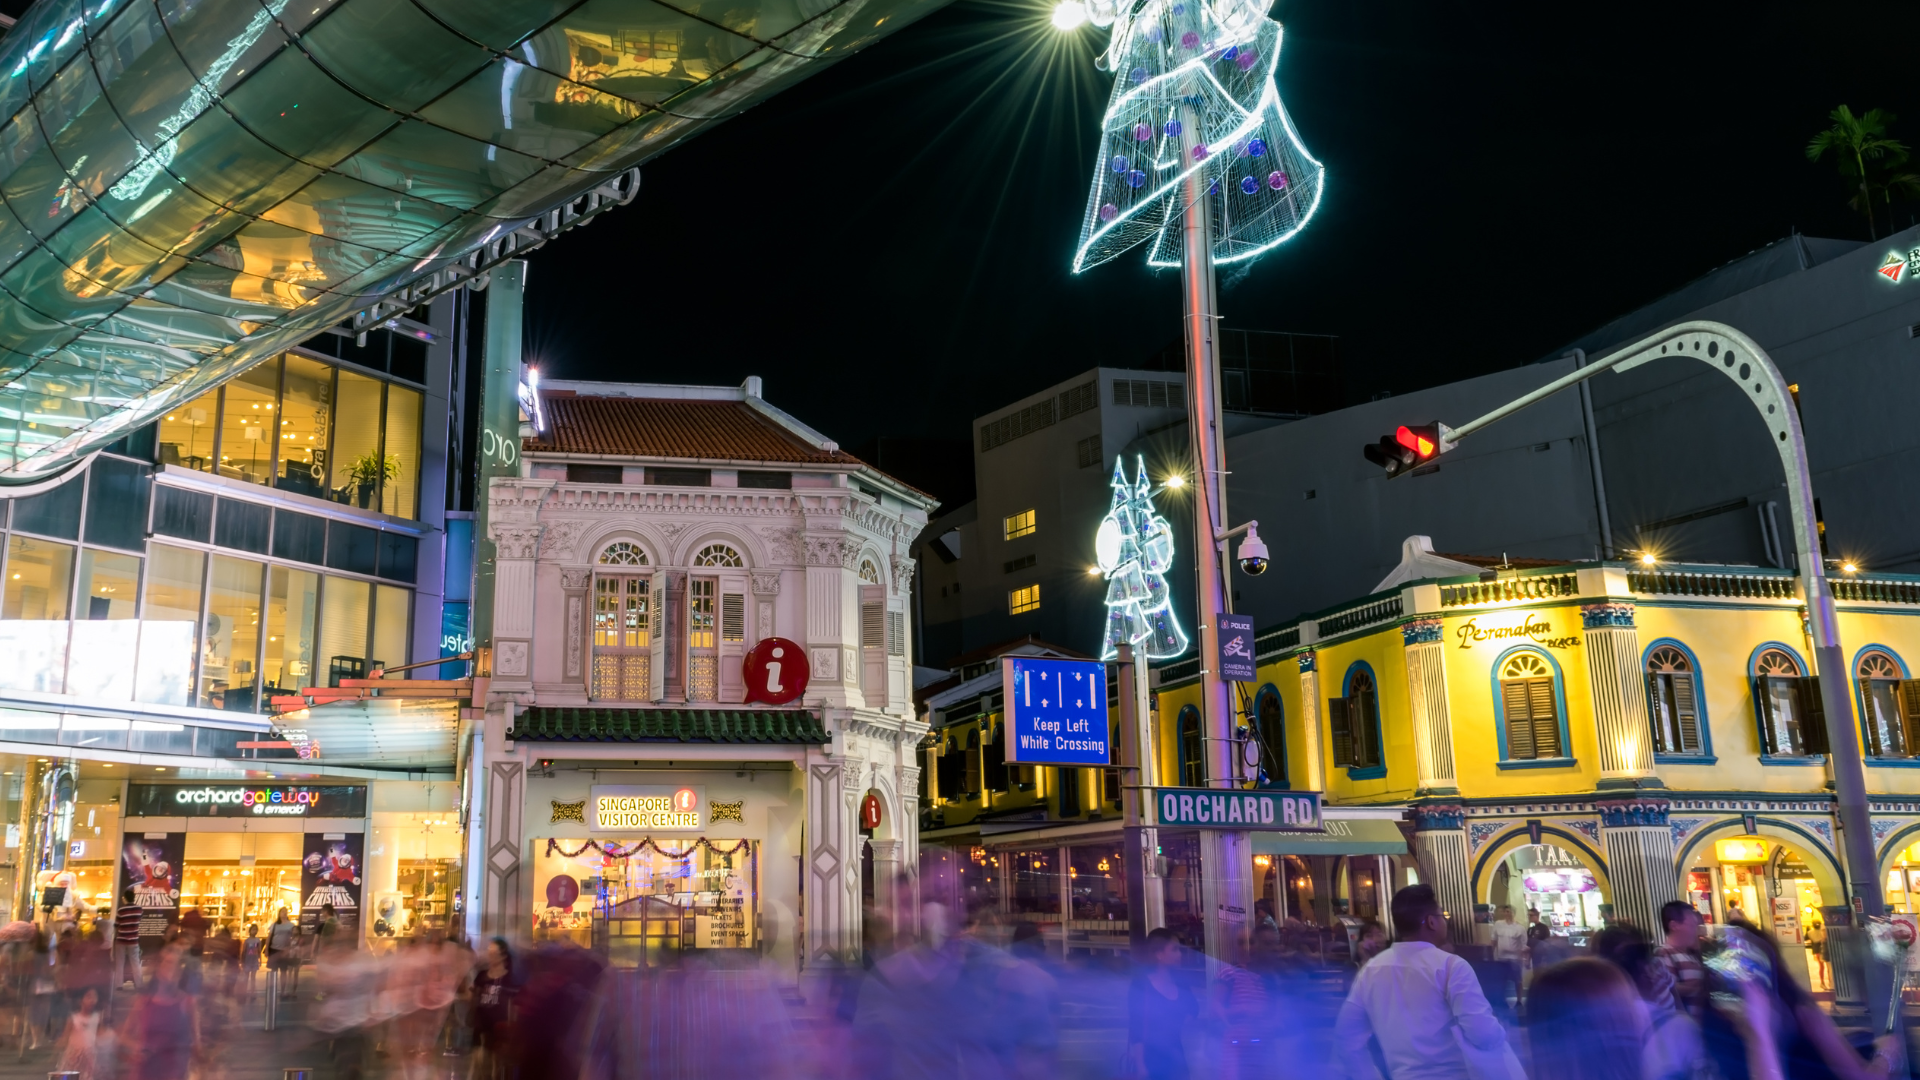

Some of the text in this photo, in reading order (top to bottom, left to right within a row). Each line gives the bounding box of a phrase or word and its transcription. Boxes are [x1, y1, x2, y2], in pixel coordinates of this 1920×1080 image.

[310, 381, 330, 479] Crate&Barrel
[1230, 622, 1250, 630] POLICE
[1457, 613, 1551, 649] Peranakan
[1547, 636, 1582, 649] PLACE
[1033, 716, 1089, 735] Keep Left
[1020, 734, 1105, 755] While Crossing
[176, 787, 319, 807] orchardgateway
[599, 797, 670, 811] SINGAPORE
[264, 803, 306, 814] emerald
[1163, 793, 1313, 824] ORCHARD RD
[599, 813, 698, 826] VISITOR CENTRE
[1324, 820, 1353, 836] OUT
[1533, 845, 1578, 861] TAK
[305, 893, 356, 906] CHRISTMAS
